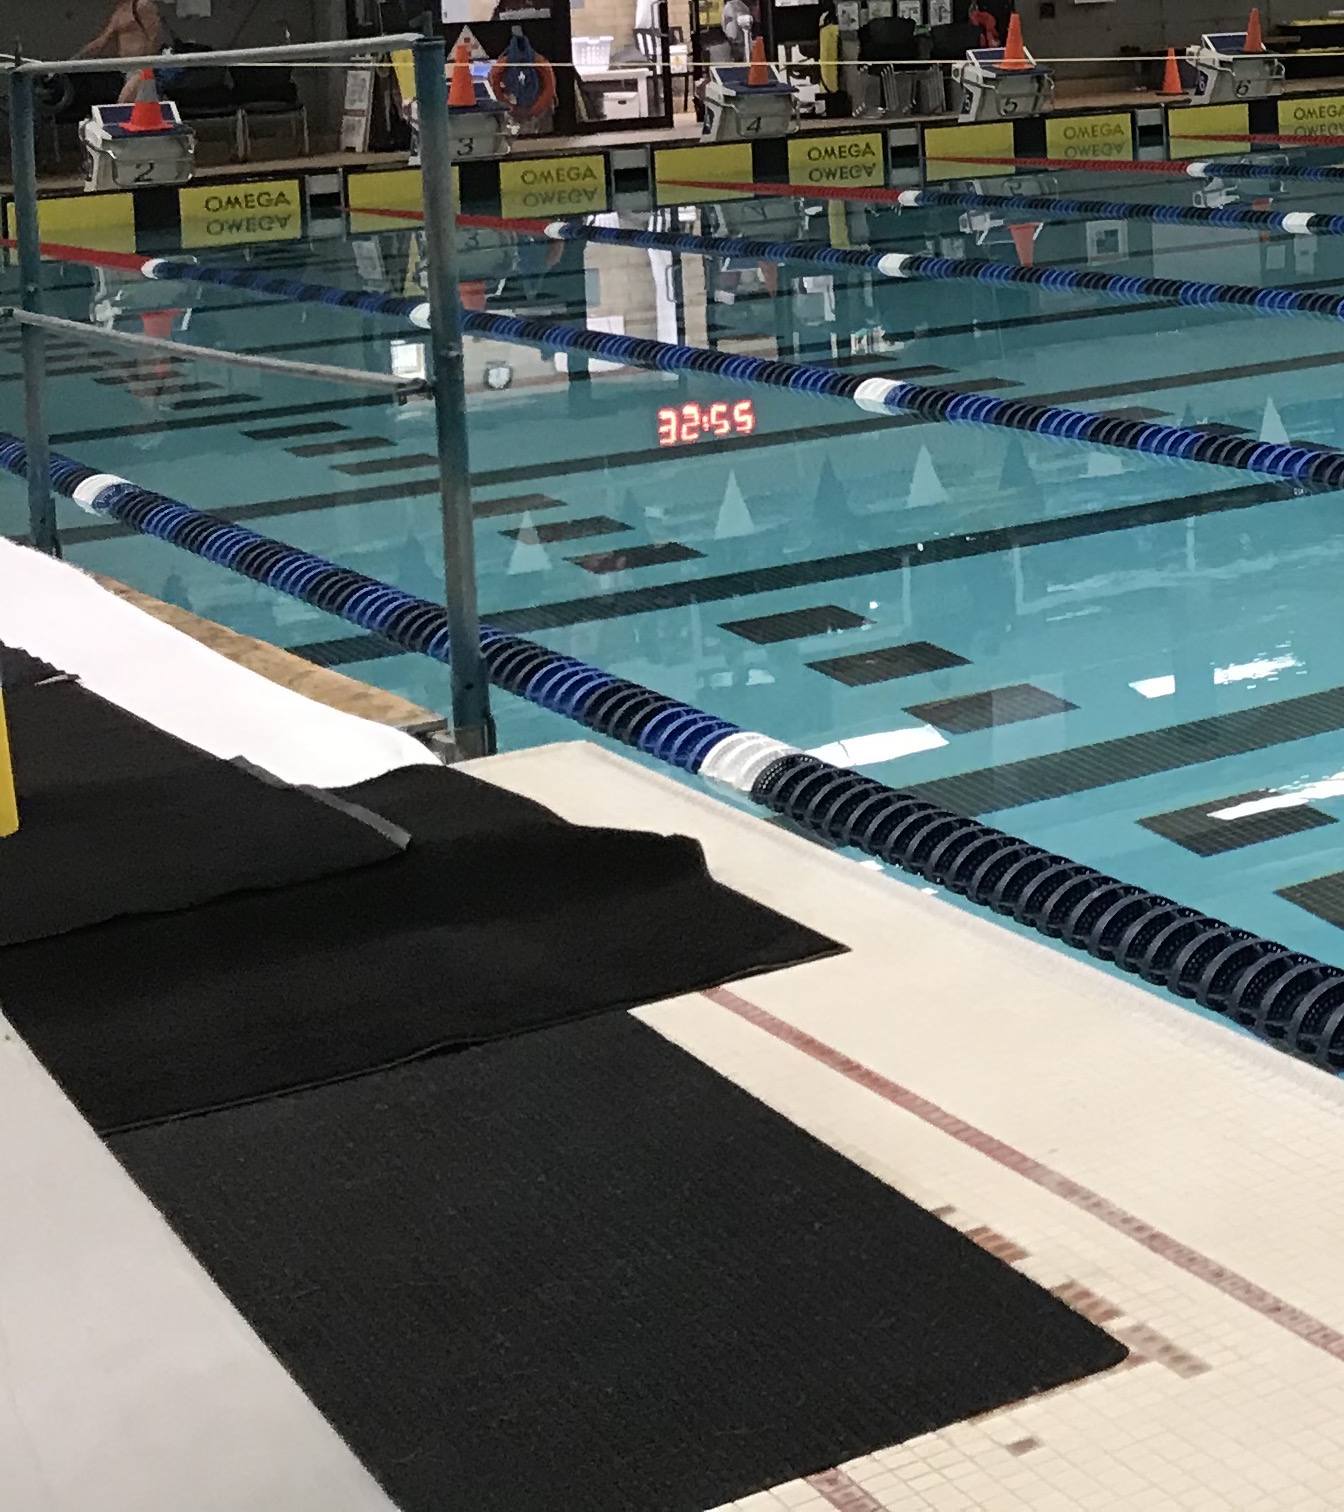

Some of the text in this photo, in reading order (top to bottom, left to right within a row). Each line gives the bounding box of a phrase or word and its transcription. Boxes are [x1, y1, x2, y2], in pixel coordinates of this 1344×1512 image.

[1236, 79, 1251, 97] 6
[1002, 97, 1019, 116] 5
[746, 116, 762, 134] 4
[1063, 123, 1125, 140] OMEGA
[456, 137, 474, 156] 3
[807, 142, 876, 161] OMEGA
[133, 162, 155, 183] 2
[520, 166, 598, 185] OMEGA
[204, 191, 292, 213] OMEGA
